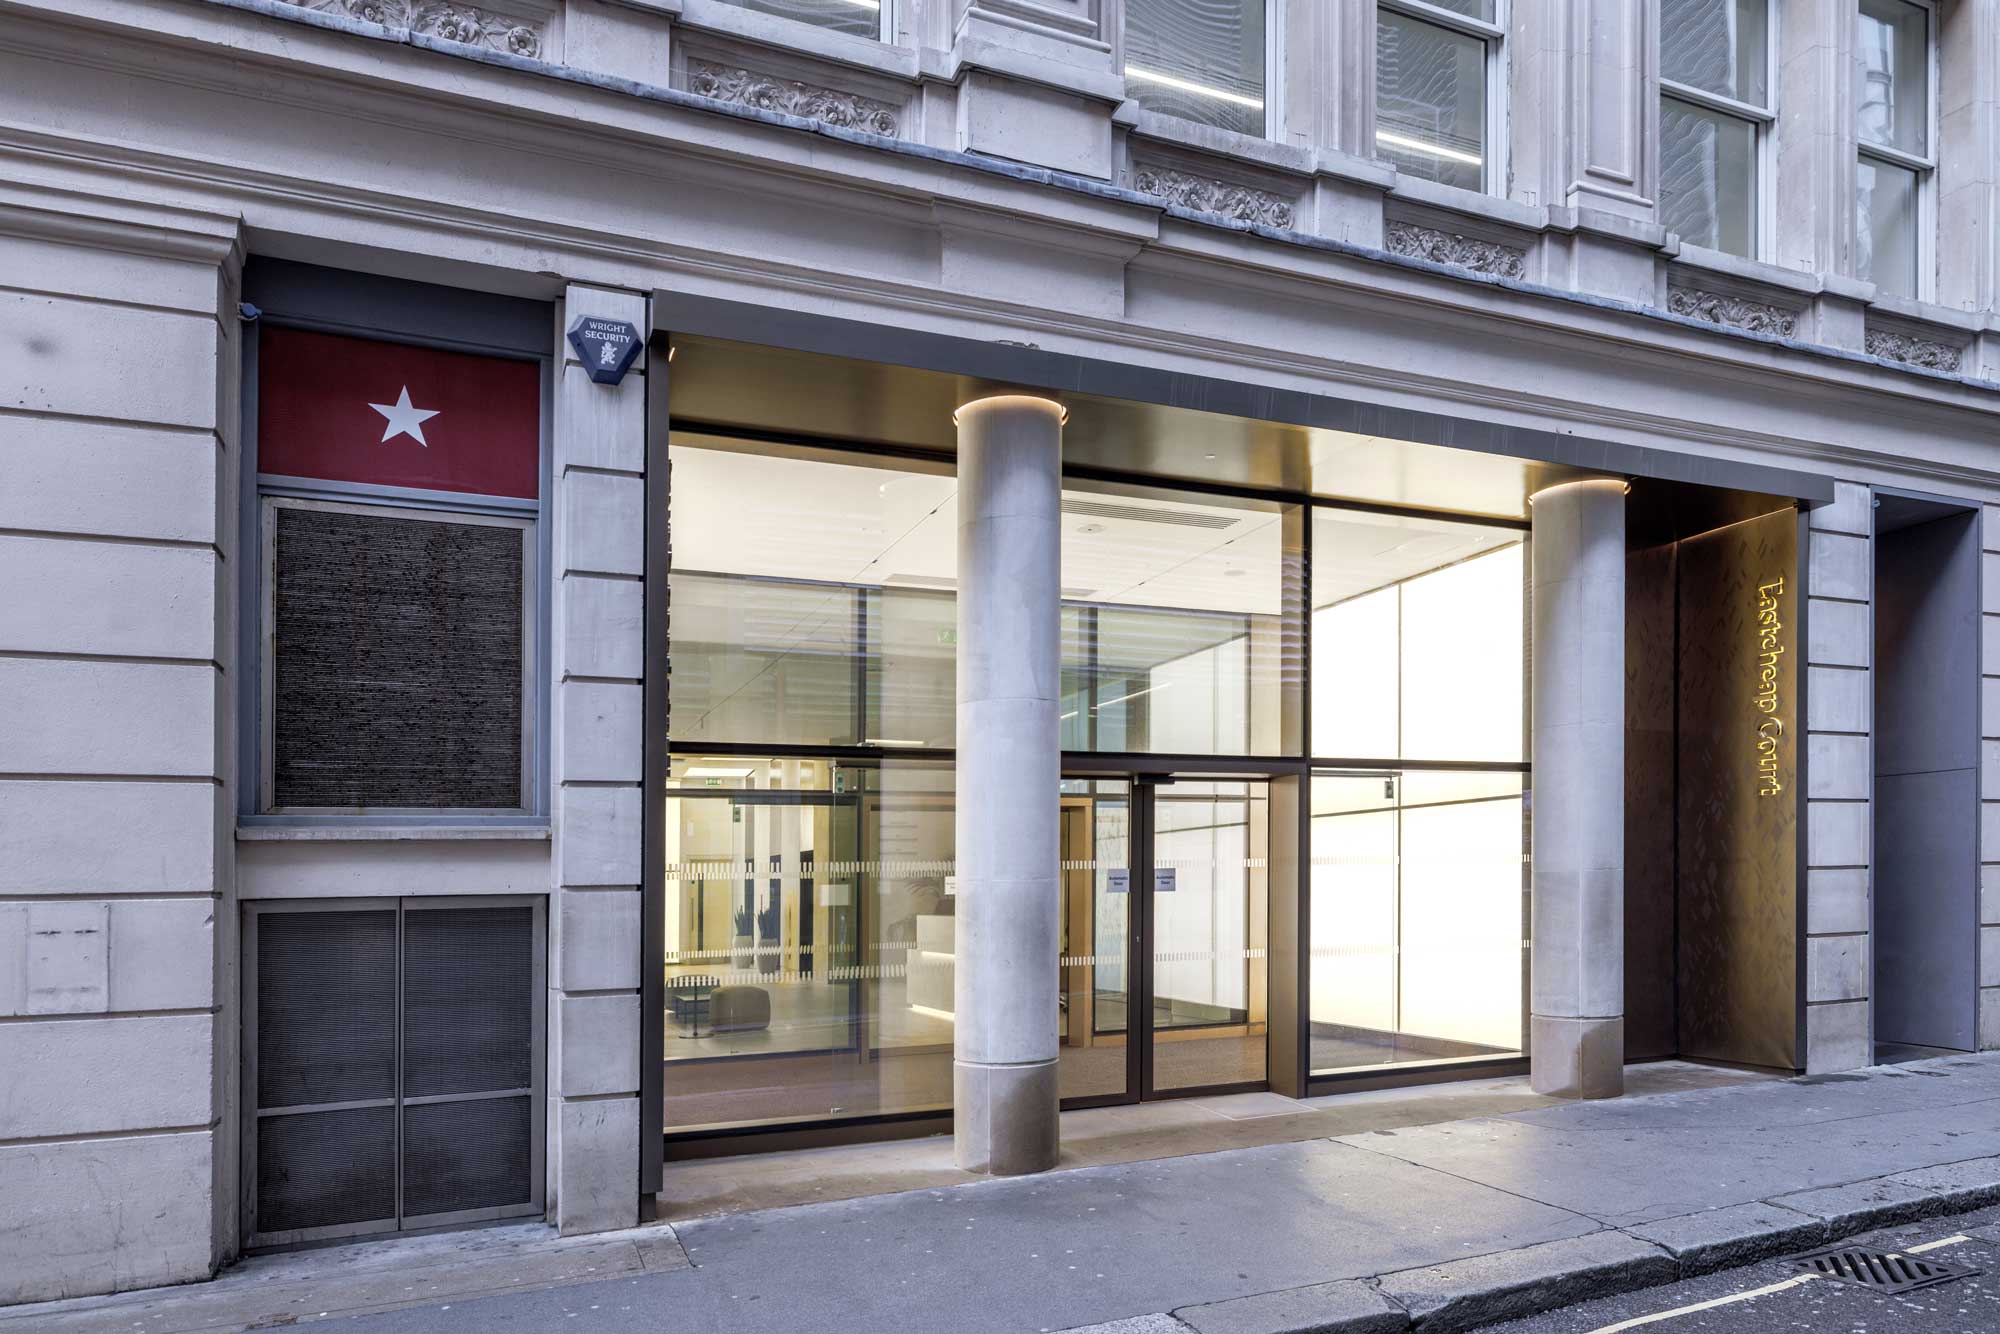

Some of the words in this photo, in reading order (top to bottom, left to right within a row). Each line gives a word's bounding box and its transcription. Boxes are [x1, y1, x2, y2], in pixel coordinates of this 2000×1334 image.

[584, 330, 631, 343] SECURITY
[589, 321, 627, 334] WRIGHT
[1753, 576, 1785, 713] Eastcheap
[1757, 716, 1785, 797] Court
